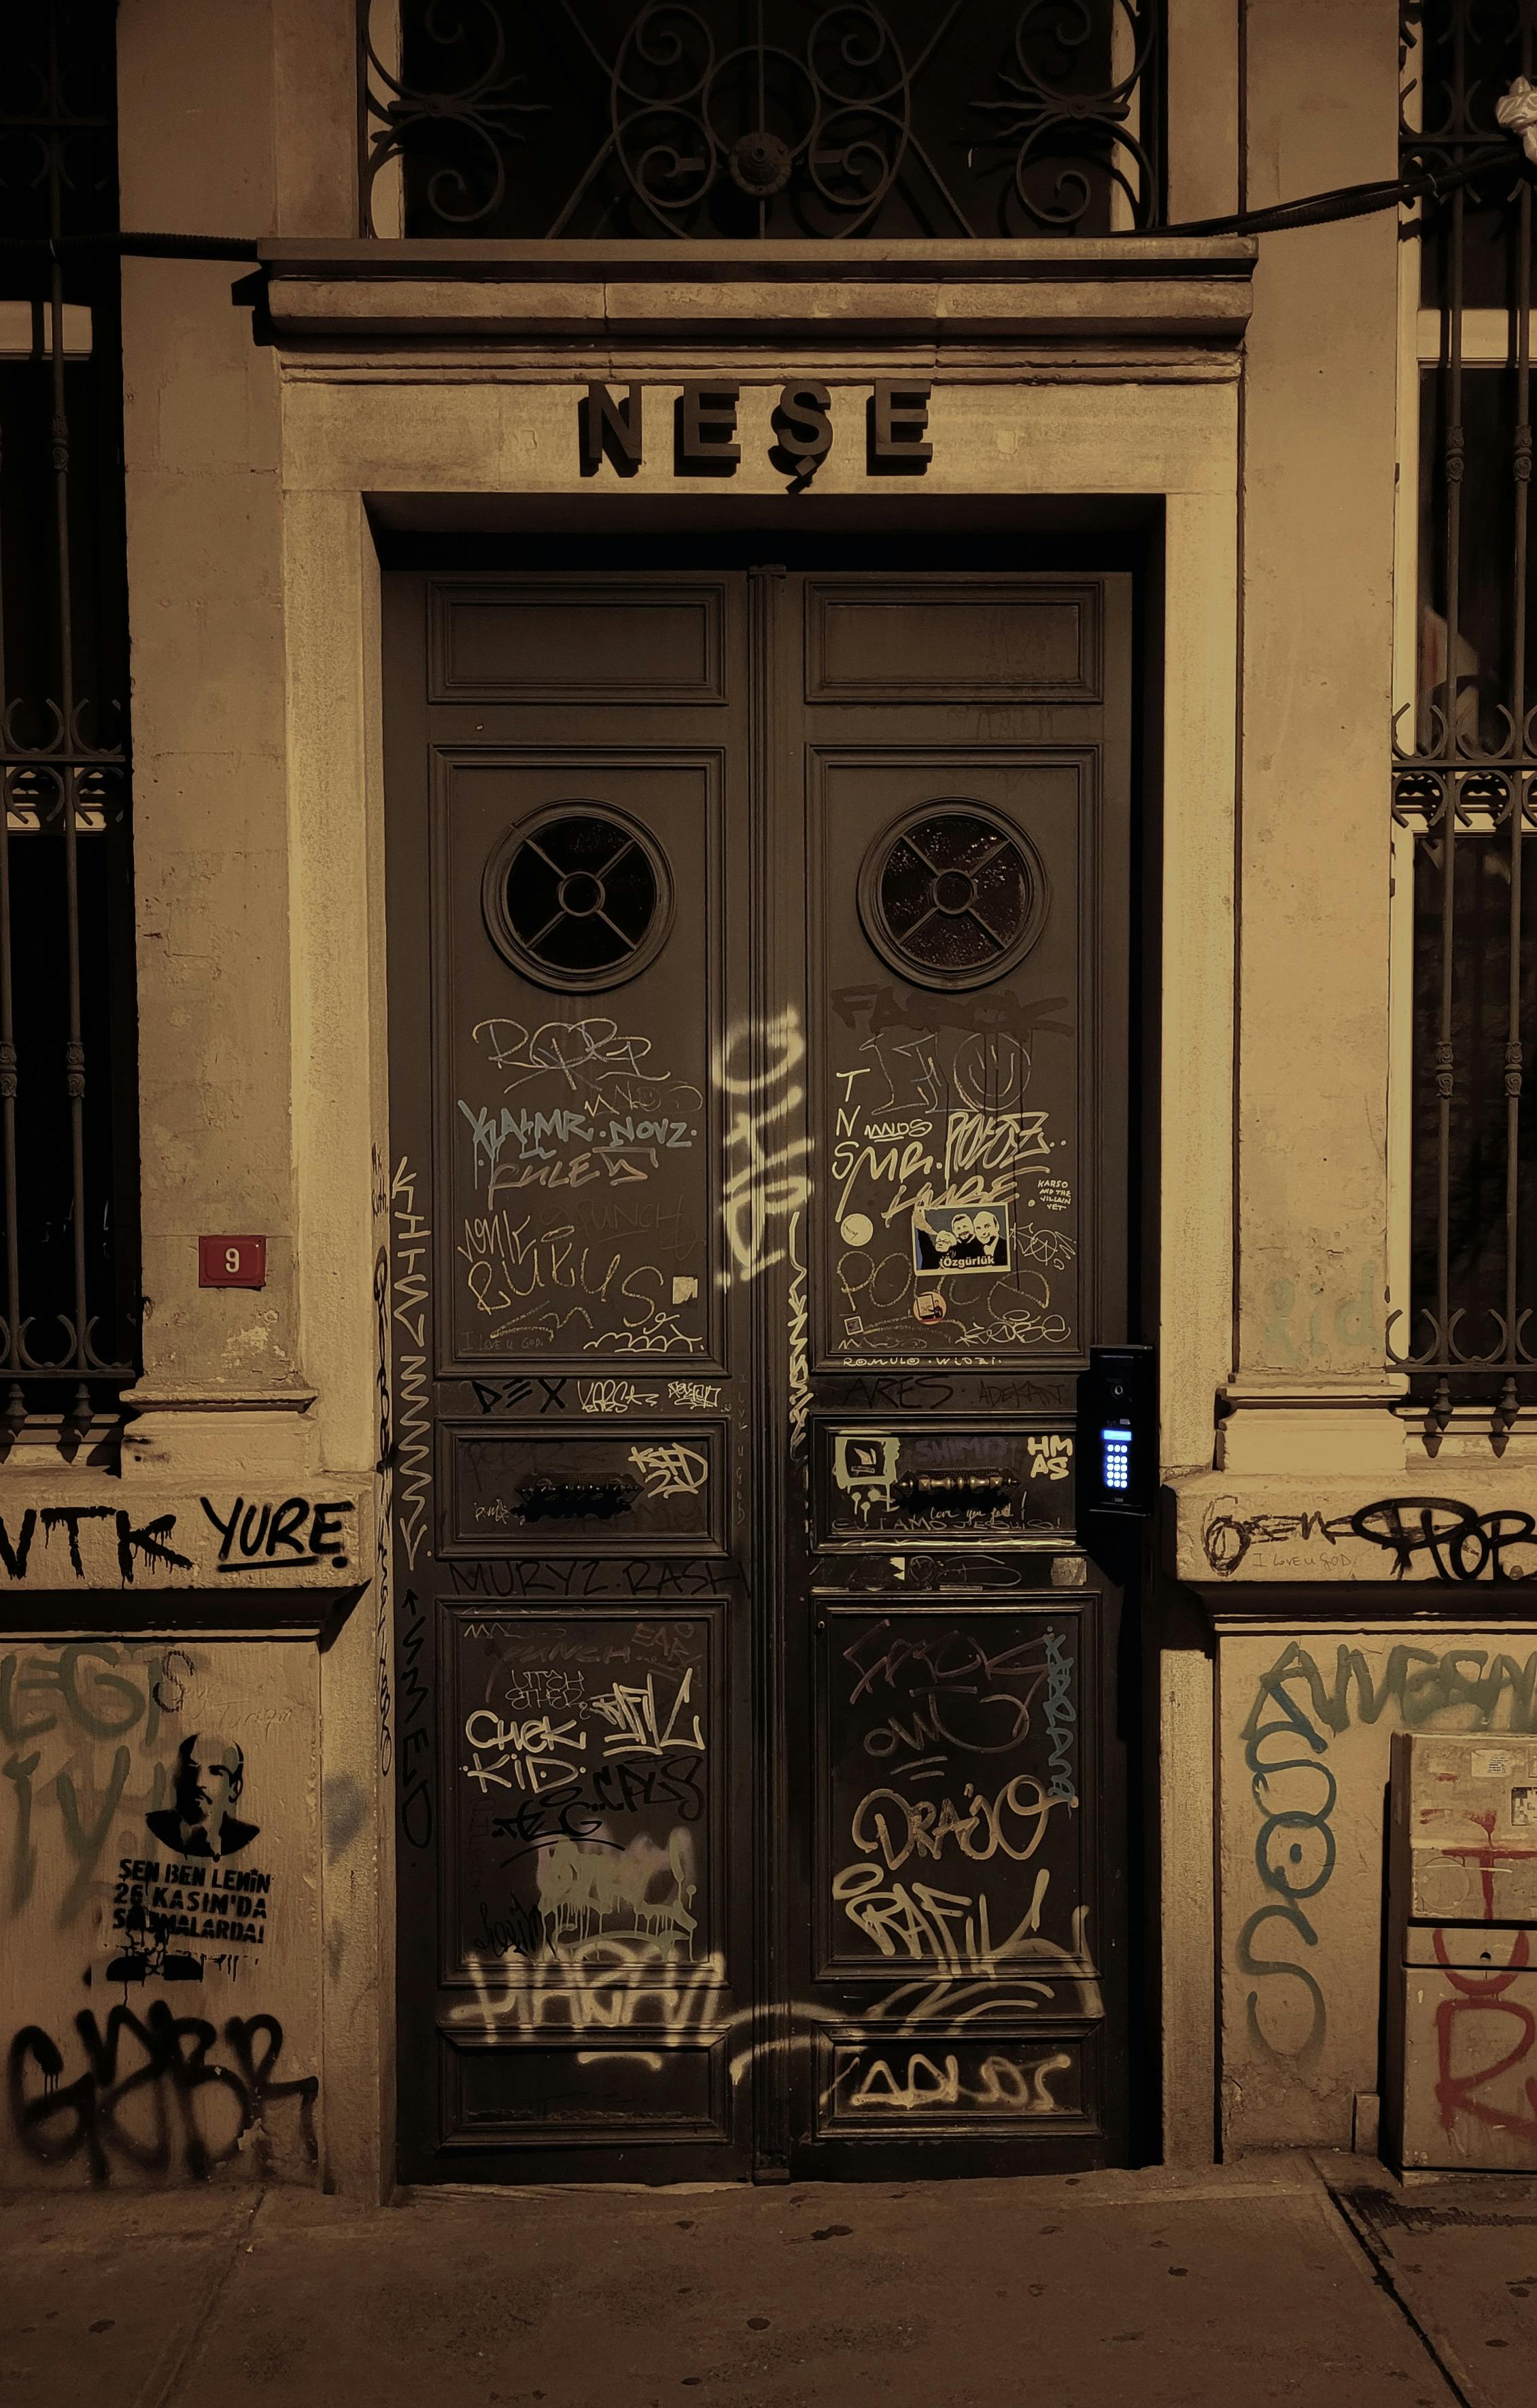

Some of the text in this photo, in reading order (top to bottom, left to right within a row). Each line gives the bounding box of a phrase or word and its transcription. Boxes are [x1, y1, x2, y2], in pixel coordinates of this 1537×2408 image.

[583, 379, 933, 479] NEŞE
[224, 1248, 240, 1273] 9
[942, 1255, 995, 1269] Özgürlük
[118, 1858, 160, 1883] SEN
[165, 1863, 206, 1887] BEN
